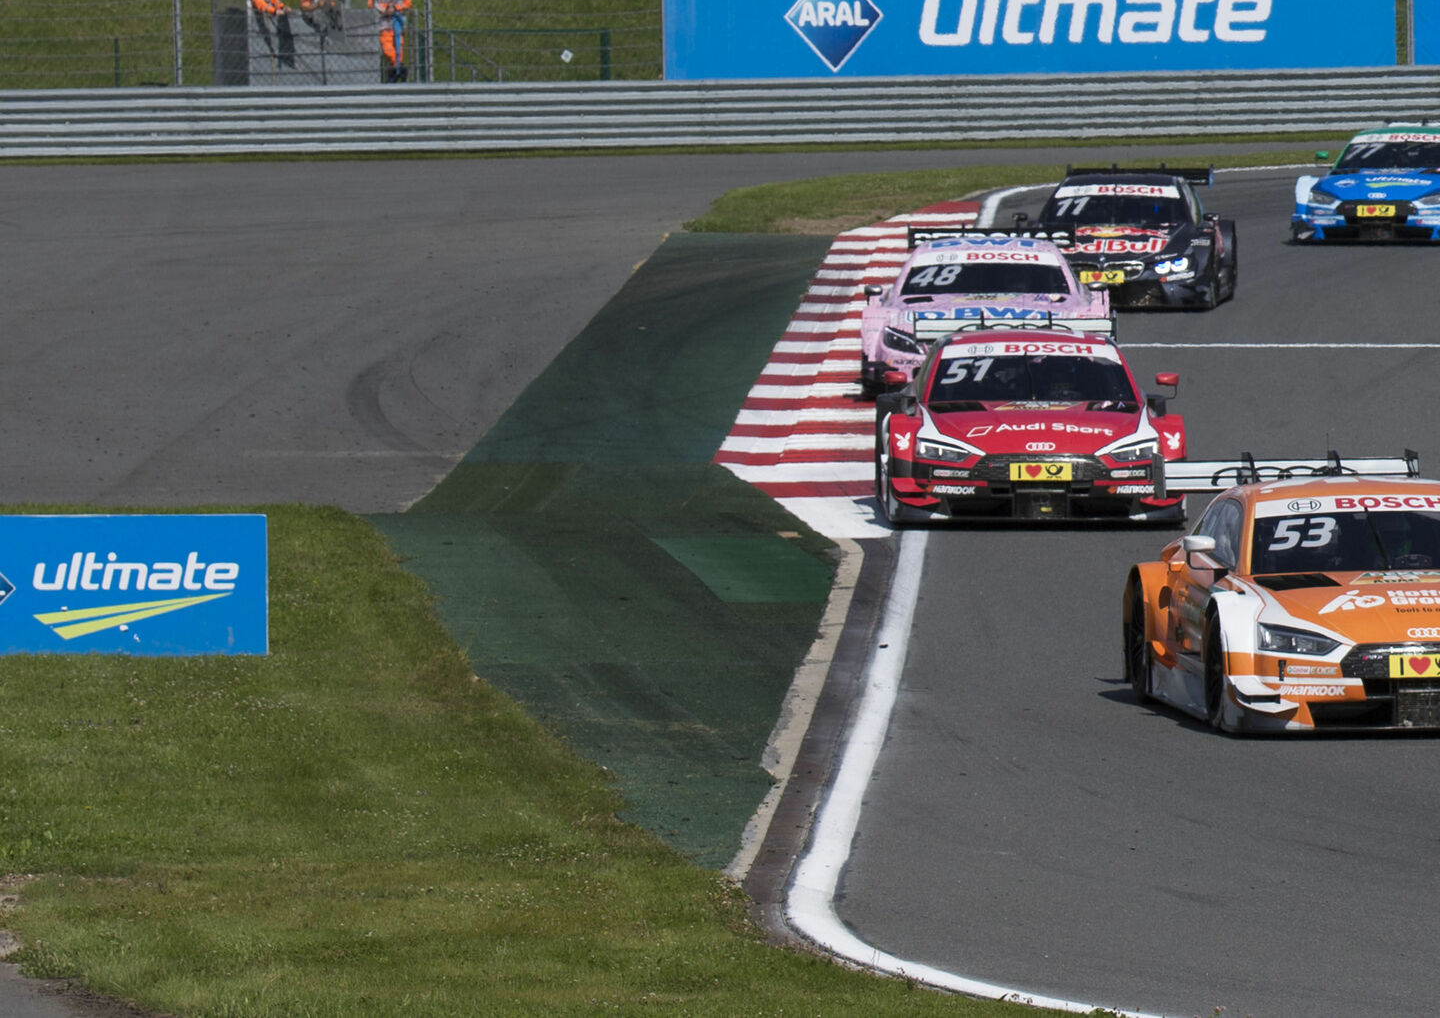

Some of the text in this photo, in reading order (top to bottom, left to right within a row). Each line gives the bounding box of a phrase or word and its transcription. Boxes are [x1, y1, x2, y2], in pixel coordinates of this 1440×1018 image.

[798, 1, 870, 28] ARAL
[1097, 185, 1163, 194] BOSCH
[1056, 196, 1091, 217] 11
[966, 252, 1039, 262] BOSCH
[910, 265, 962, 287] 48
[1004, 344, 1093, 354] BOSCH
[940, 358, 994, 384] 51
[996, 423, 1113, 436] Audi Sport
[1269, 516, 1336, 551] 53
[32, 551, 240, 591] ultimate
